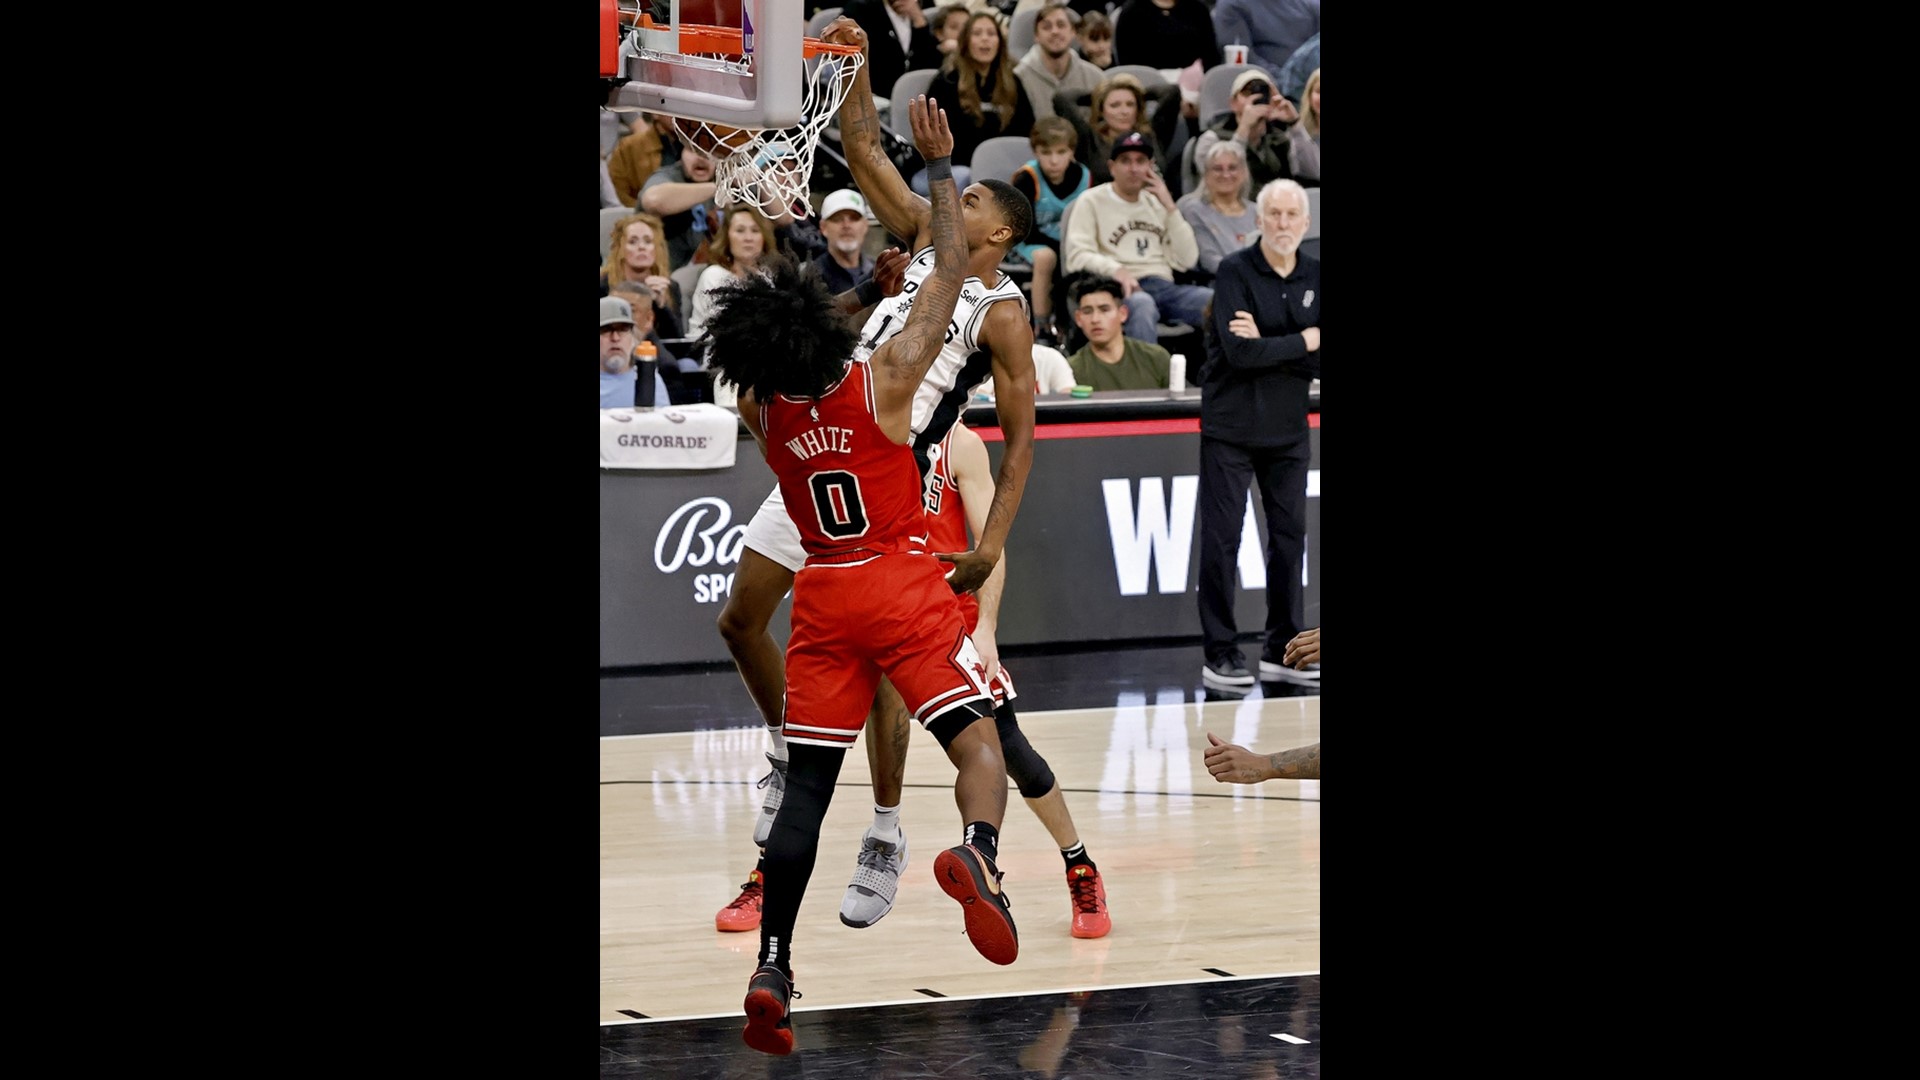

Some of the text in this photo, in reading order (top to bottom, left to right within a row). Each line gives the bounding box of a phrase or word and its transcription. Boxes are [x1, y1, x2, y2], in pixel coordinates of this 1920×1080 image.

[865, 315, 902, 350] 1
[617, 434, 707, 449] GATORADE
[785, 426, 853, 460] WHITE
[808, 470, 870, 540] 0
[654, 497, 748, 573] Ba
